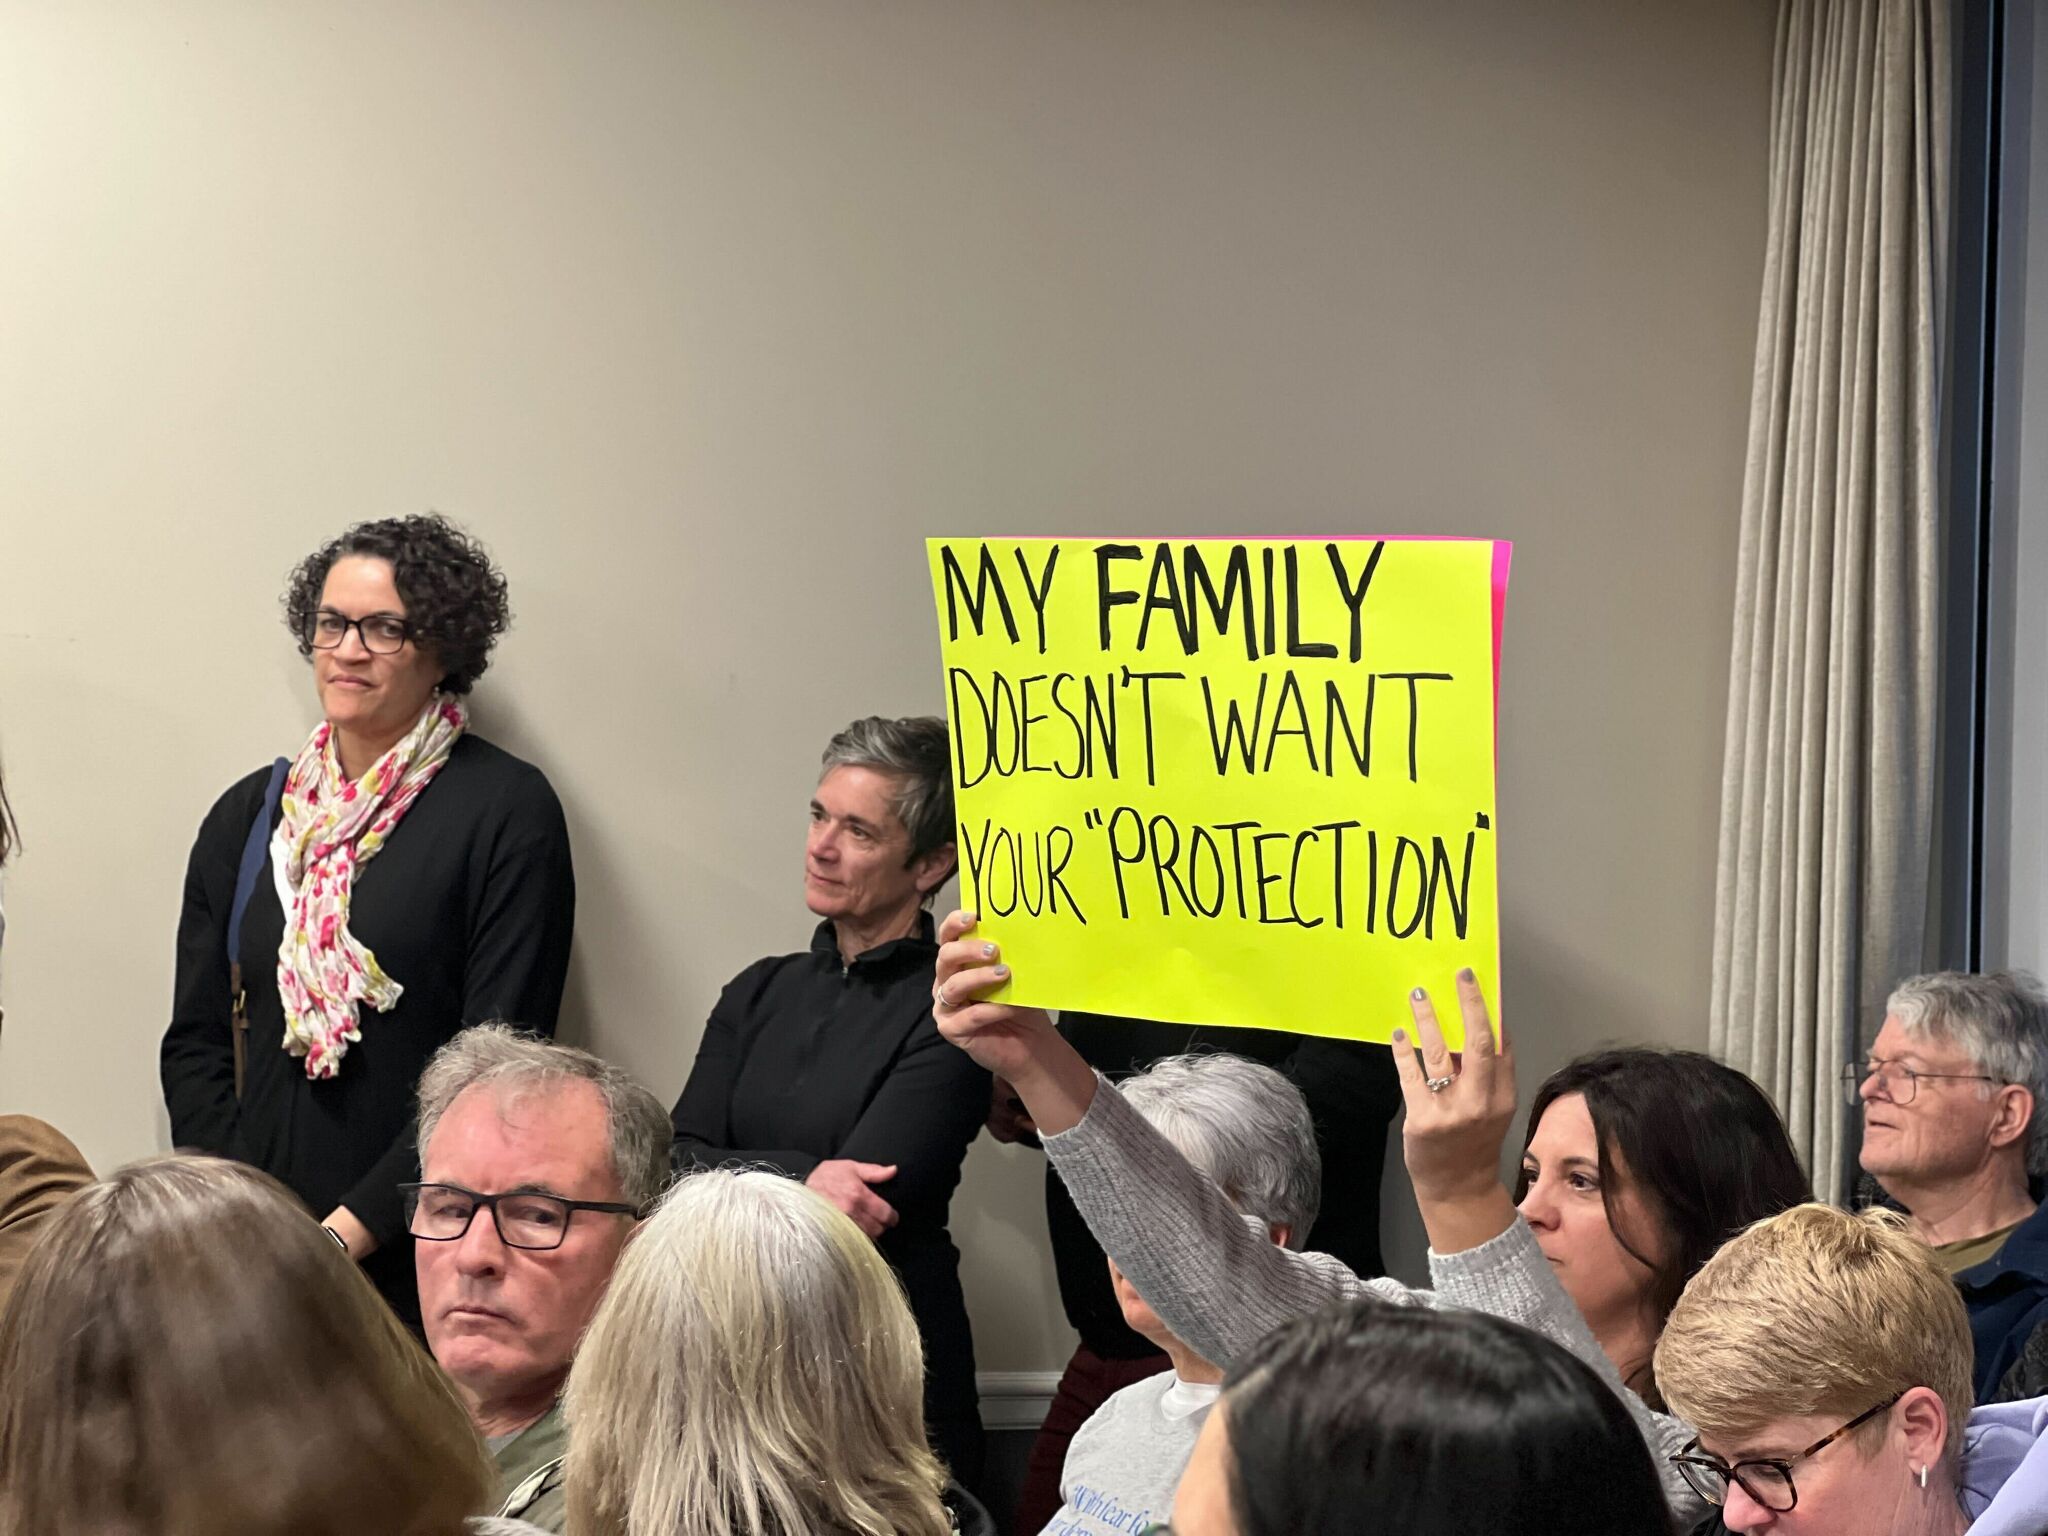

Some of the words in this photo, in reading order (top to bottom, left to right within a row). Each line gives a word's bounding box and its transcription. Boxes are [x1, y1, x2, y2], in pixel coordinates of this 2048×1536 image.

[941, 542, 1059, 654] MY
[1095, 541, 1384, 662] FAMILY
[949, 665, 1186, 788] DOESN'T
[1201, 670, 1453, 783] WANT
[961, 818, 1086, 924] YOUR
[1084, 807, 1490, 940] "PROTECTION"
[1126, 1510, 1149, 1536] fo
